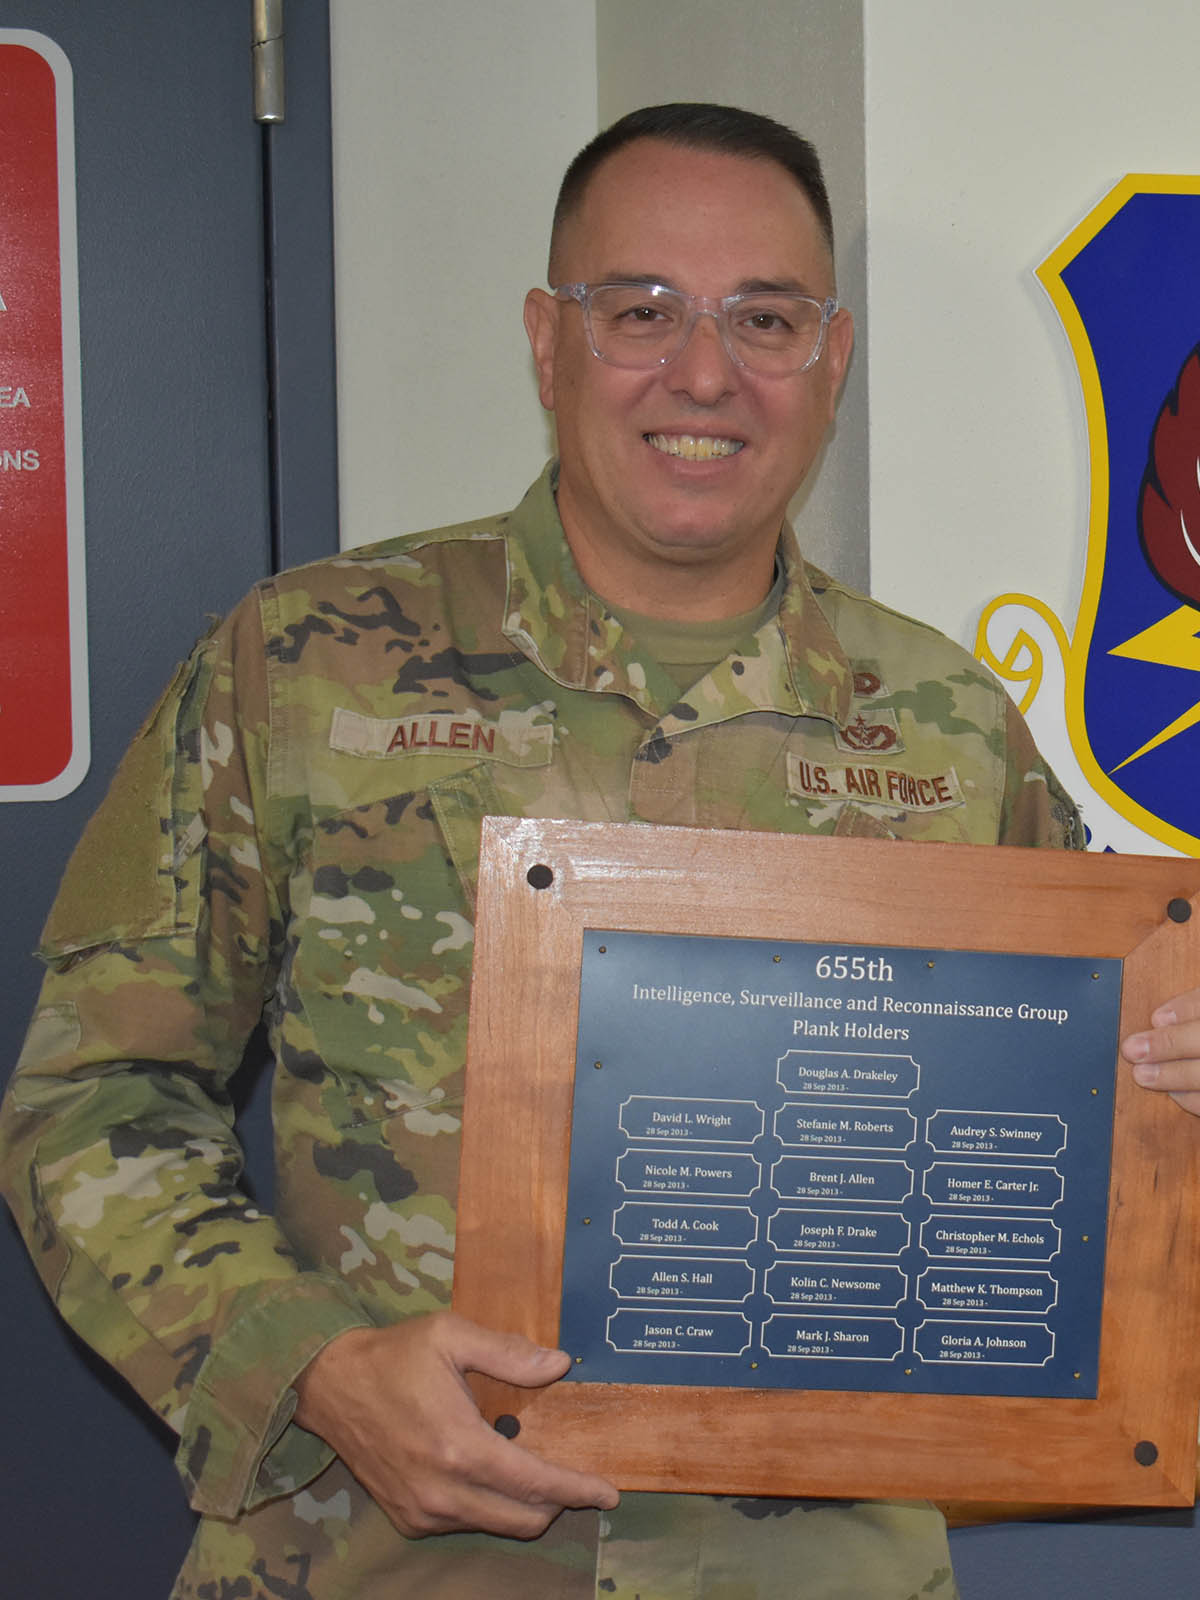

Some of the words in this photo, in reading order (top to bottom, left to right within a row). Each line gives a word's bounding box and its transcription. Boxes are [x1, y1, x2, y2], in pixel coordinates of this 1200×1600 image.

[0, 449, 40, 471] NS
[386, 720, 496, 752] ALLEN
[799, 760, 839, 795] U.S.
[845, 767, 882, 798] AIR
[885, 769, 953, 806] FORCE
[816, 955, 893, 982] 655th
[633, 984, 735, 1006] Intelligence,
[739, 989, 842, 1009] Surveillance
[846, 995, 877, 1011] and
[882, 996, 1013, 1018] Reconnaissance
[1017, 1003, 1068, 1025] Group
[792, 1019, 839, 1037] Plank
[844, 1022, 909, 1040] Holders
[798, 1066, 839, 1080] Douglas
[840, 1068, 851, 1079] A.
[853, 1069, 898, 1084] Drakeley
[813, 1082, 826, 1092] Sep
[652, 1111, 682, 1123] David
[684, 1113, 693, 1124] L.
[695, 1113, 731, 1127] Wright
[796, 1118, 837, 1130] Stefanie
[839, 1120, 852, 1131] M.
[854, 1120, 894, 1133] Roberts
[656, 1127, 669, 1136] Sep
[950, 1125, 987, 1139] Audrey
[988, 1127, 997, 1137] S.
[999, 1127, 1042, 1142] Swinney
[810, 1134, 823, 1144] Sep
[961, 1141, 975, 1150] Sep
[645, 1164, 678, 1176] Nicole
[679, 1166, 692, 1176] M.
[694, 1166, 732, 1178] Powers
[809, 1171, 838, 1183] Brent
[839, 1172, 846, 1184] J.
[848, 1173, 875, 1184] Allen
[653, 1180, 666, 1190] Sep
[806, 1186, 820, 1196] Sep
[947, 1177, 982, 1189] Homer
[984, 1179, 993, 1190] E.
[995, 1179, 1028, 1191] Carter
[1028, 1181, 1039, 1192] Jr.
[958, 1193, 972, 1202] Sep
[651, 1218, 678, 1229] Todd
[679, 1219, 690, 1230] A.
[692, 1220, 719, 1231] Cook
[800, 1224, 834, 1237] Joseph
[836, 1225, 844, 1236] F.
[847, 1226, 877, 1237] Drake
[649, 1233, 663, 1243] Sep
[935, 1229, 996, 1244] Christopher
[997, 1232, 1010, 1242] M.
[1011, 1232, 1044, 1244] Echols
[803, 1239, 817, 1249] Sep
[955, 1246, 968, 1255] Sep
[651, 1271, 678, 1282] Allen
[680, 1272, 690, 1282] S.
[692, 1272, 712, 1284] Hall
[790, 1276, 817, 1287] Kolin
[819, 1278, 829, 1288] C.
[831, 1278, 881, 1290] Newsome
[646, 1286, 660, 1296] Sep
[800, 1292, 814, 1301] Sep
[931, 1282, 976, 1293] Matthew
[977, 1283, 987, 1294] K.
[989, 1284, 1043, 1298] Thompson
[952, 1298, 965, 1307] Sep
[644, 1324, 672, 1336] Jason
[674, 1325, 684, 1336] C.
[686, 1325, 714, 1336] Craw
[796, 1329, 823, 1340] Mark
[824, 1330, 831, 1342] J.
[833, 1330, 869, 1342] Sharon
[643, 1339, 656, 1349] Sep
[941, 1334, 972, 1346] Gloria
[973, 1336, 984, 1346] A.
[985, 1336, 1026, 1348] Johnson
[797, 1345, 810, 1354] Sep
[949, 1350, 962, 1359] Sep
